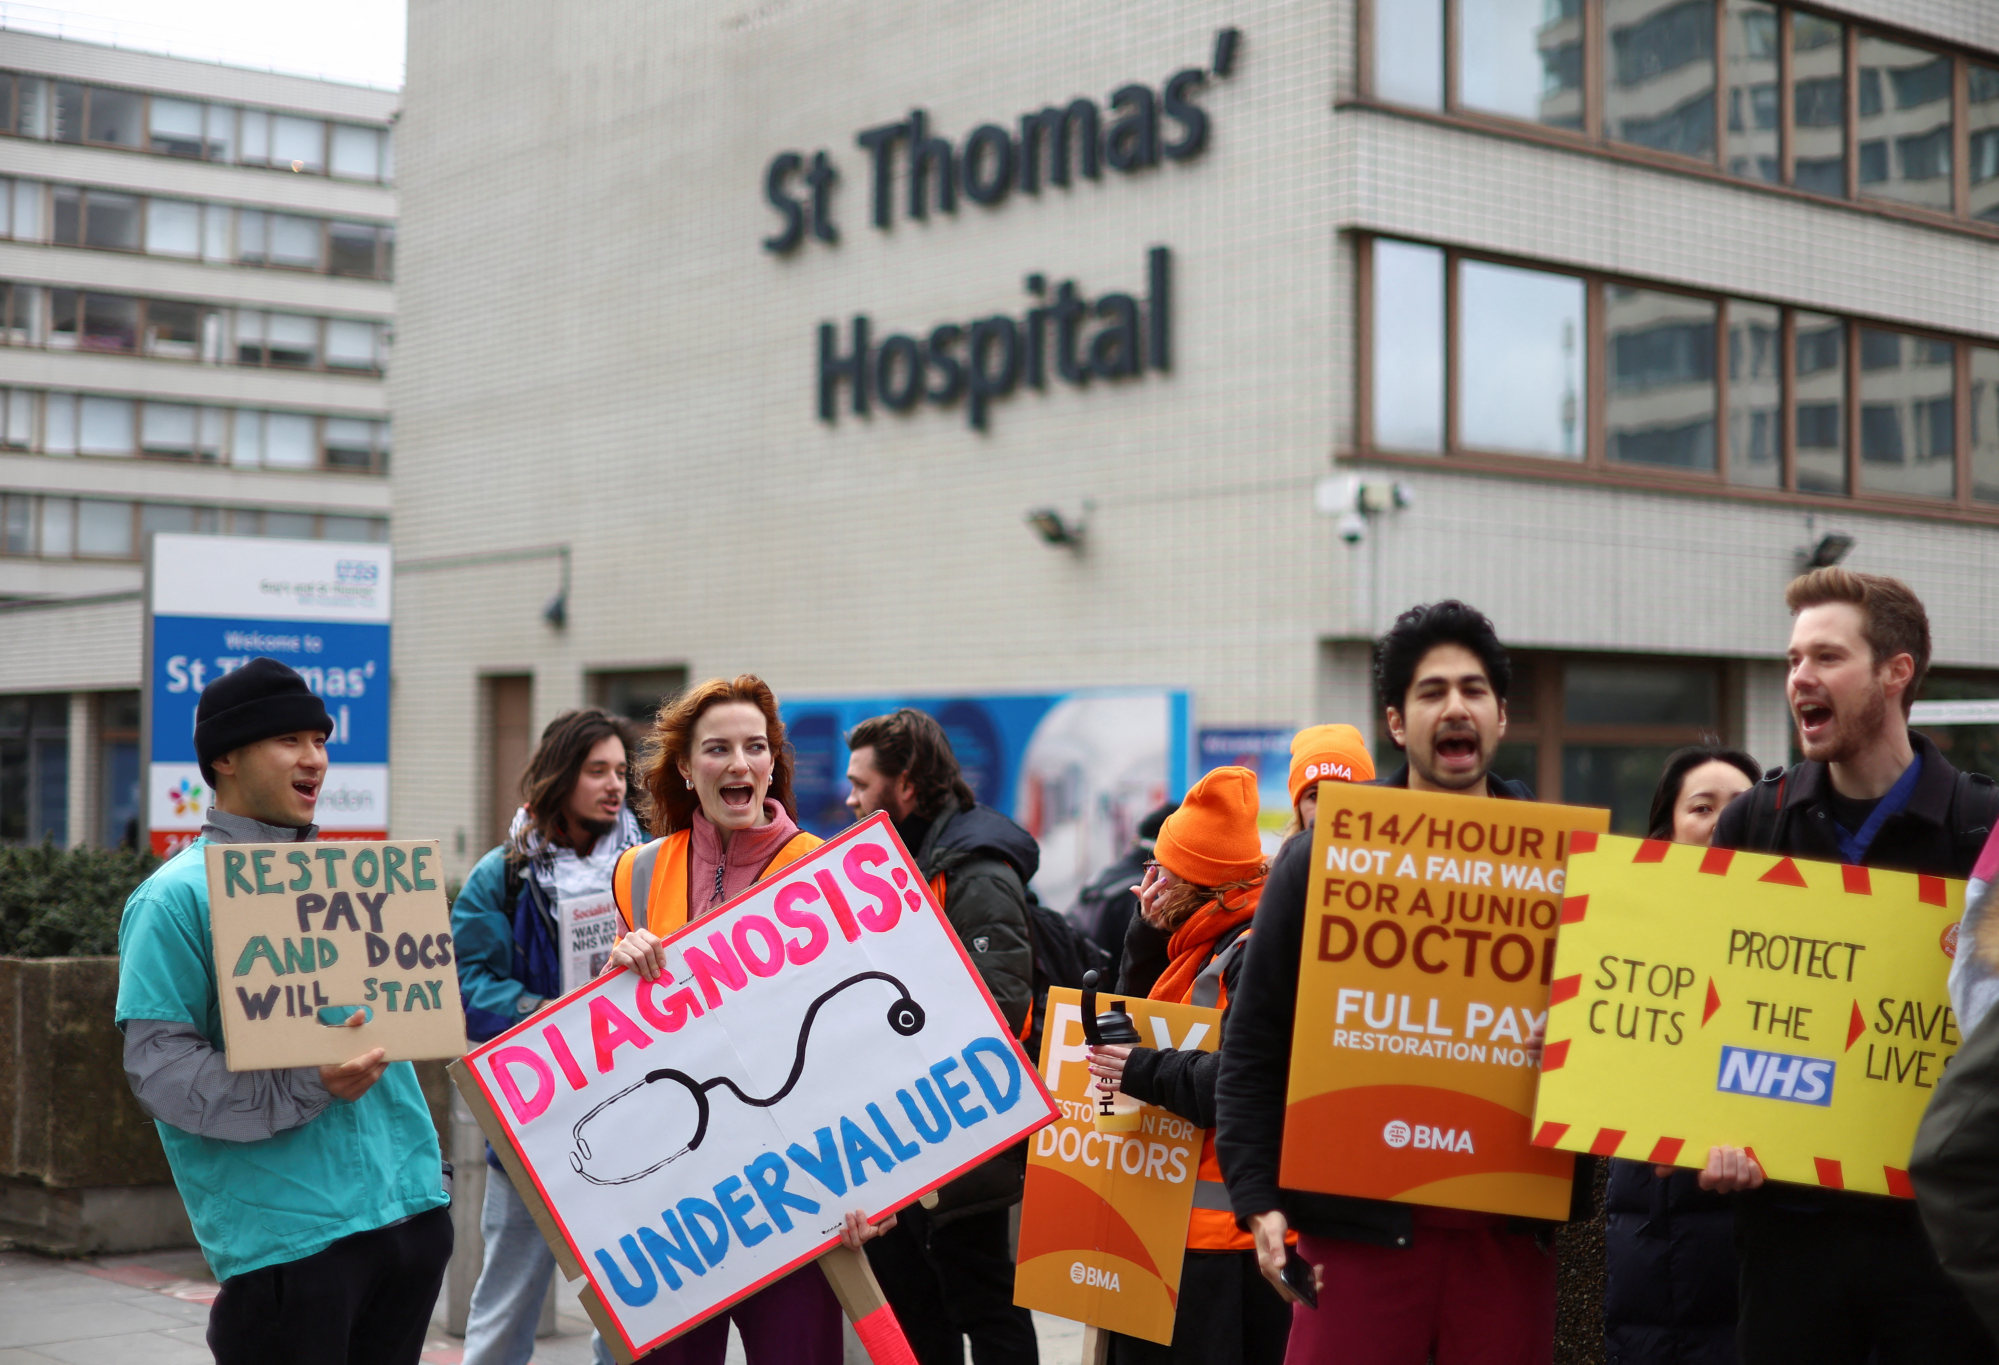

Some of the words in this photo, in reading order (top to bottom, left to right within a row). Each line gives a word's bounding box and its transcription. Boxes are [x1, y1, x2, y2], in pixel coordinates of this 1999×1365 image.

[763, 150, 839, 256] St
[856, 26, 1241, 231] Thomas'
[817, 245, 1172, 433] Hospital
[224, 629, 301, 651] Welcome
[304, 634, 322, 653] to
[166, 655, 206, 694] St
[1320, 762, 1351, 780] BMA
[1331, 807, 1546, 861] £14/HOUR
[1555, 830, 1565, 861] I
[223, 845, 438, 898] RESTORE
[1325, 845, 1391, 876] NOT
[1395, 855, 1418, 880] A
[1425, 856, 1493, 887] FAIR
[1499, 863, 1566, 895] WAG
[296, 891, 388, 933] PAY
[572, 902, 611, 920] Socialist
[1322, 877, 1400, 915] FOR
[1407, 888, 1435, 918] A
[1441, 889, 1558, 931] JUNIO
[233, 935, 339, 977] AND
[364, 932, 452, 970] DOCS
[572, 938, 598, 953] NHS
[1594, 955, 1695, 1000] STOP
[1728, 929, 1866, 982] PROTECT
[236, 980, 329, 1020] WILL
[363, 977, 443, 1012] STAY
[487, 842, 921, 1125] DIAGNOSIS:
[1335, 988, 1453, 1036] FULL
[1465, 1002, 1548, 1045] PAY
[1589, 999, 1687, 1046] CUTS
[1747, 999, 1813, 1042] THE
[1874, 998, 1958, 1046] SAVE
[1333, 1029, 1486, 1063] RESTORATION
[1099, 1076, 1115, 1116] Hue
[1719, 1050, 1834, 1102] NHS
[1158, 1117, 1195, 1142] FOR
[1413, 1125, 1475, 1154] BMA
[595, 1037, 1022, 1307] UNDERVALUED
[1036, 1123, 1190, 1184] DOCTORS
[1086, 1265, 1120, 1292] BMA
